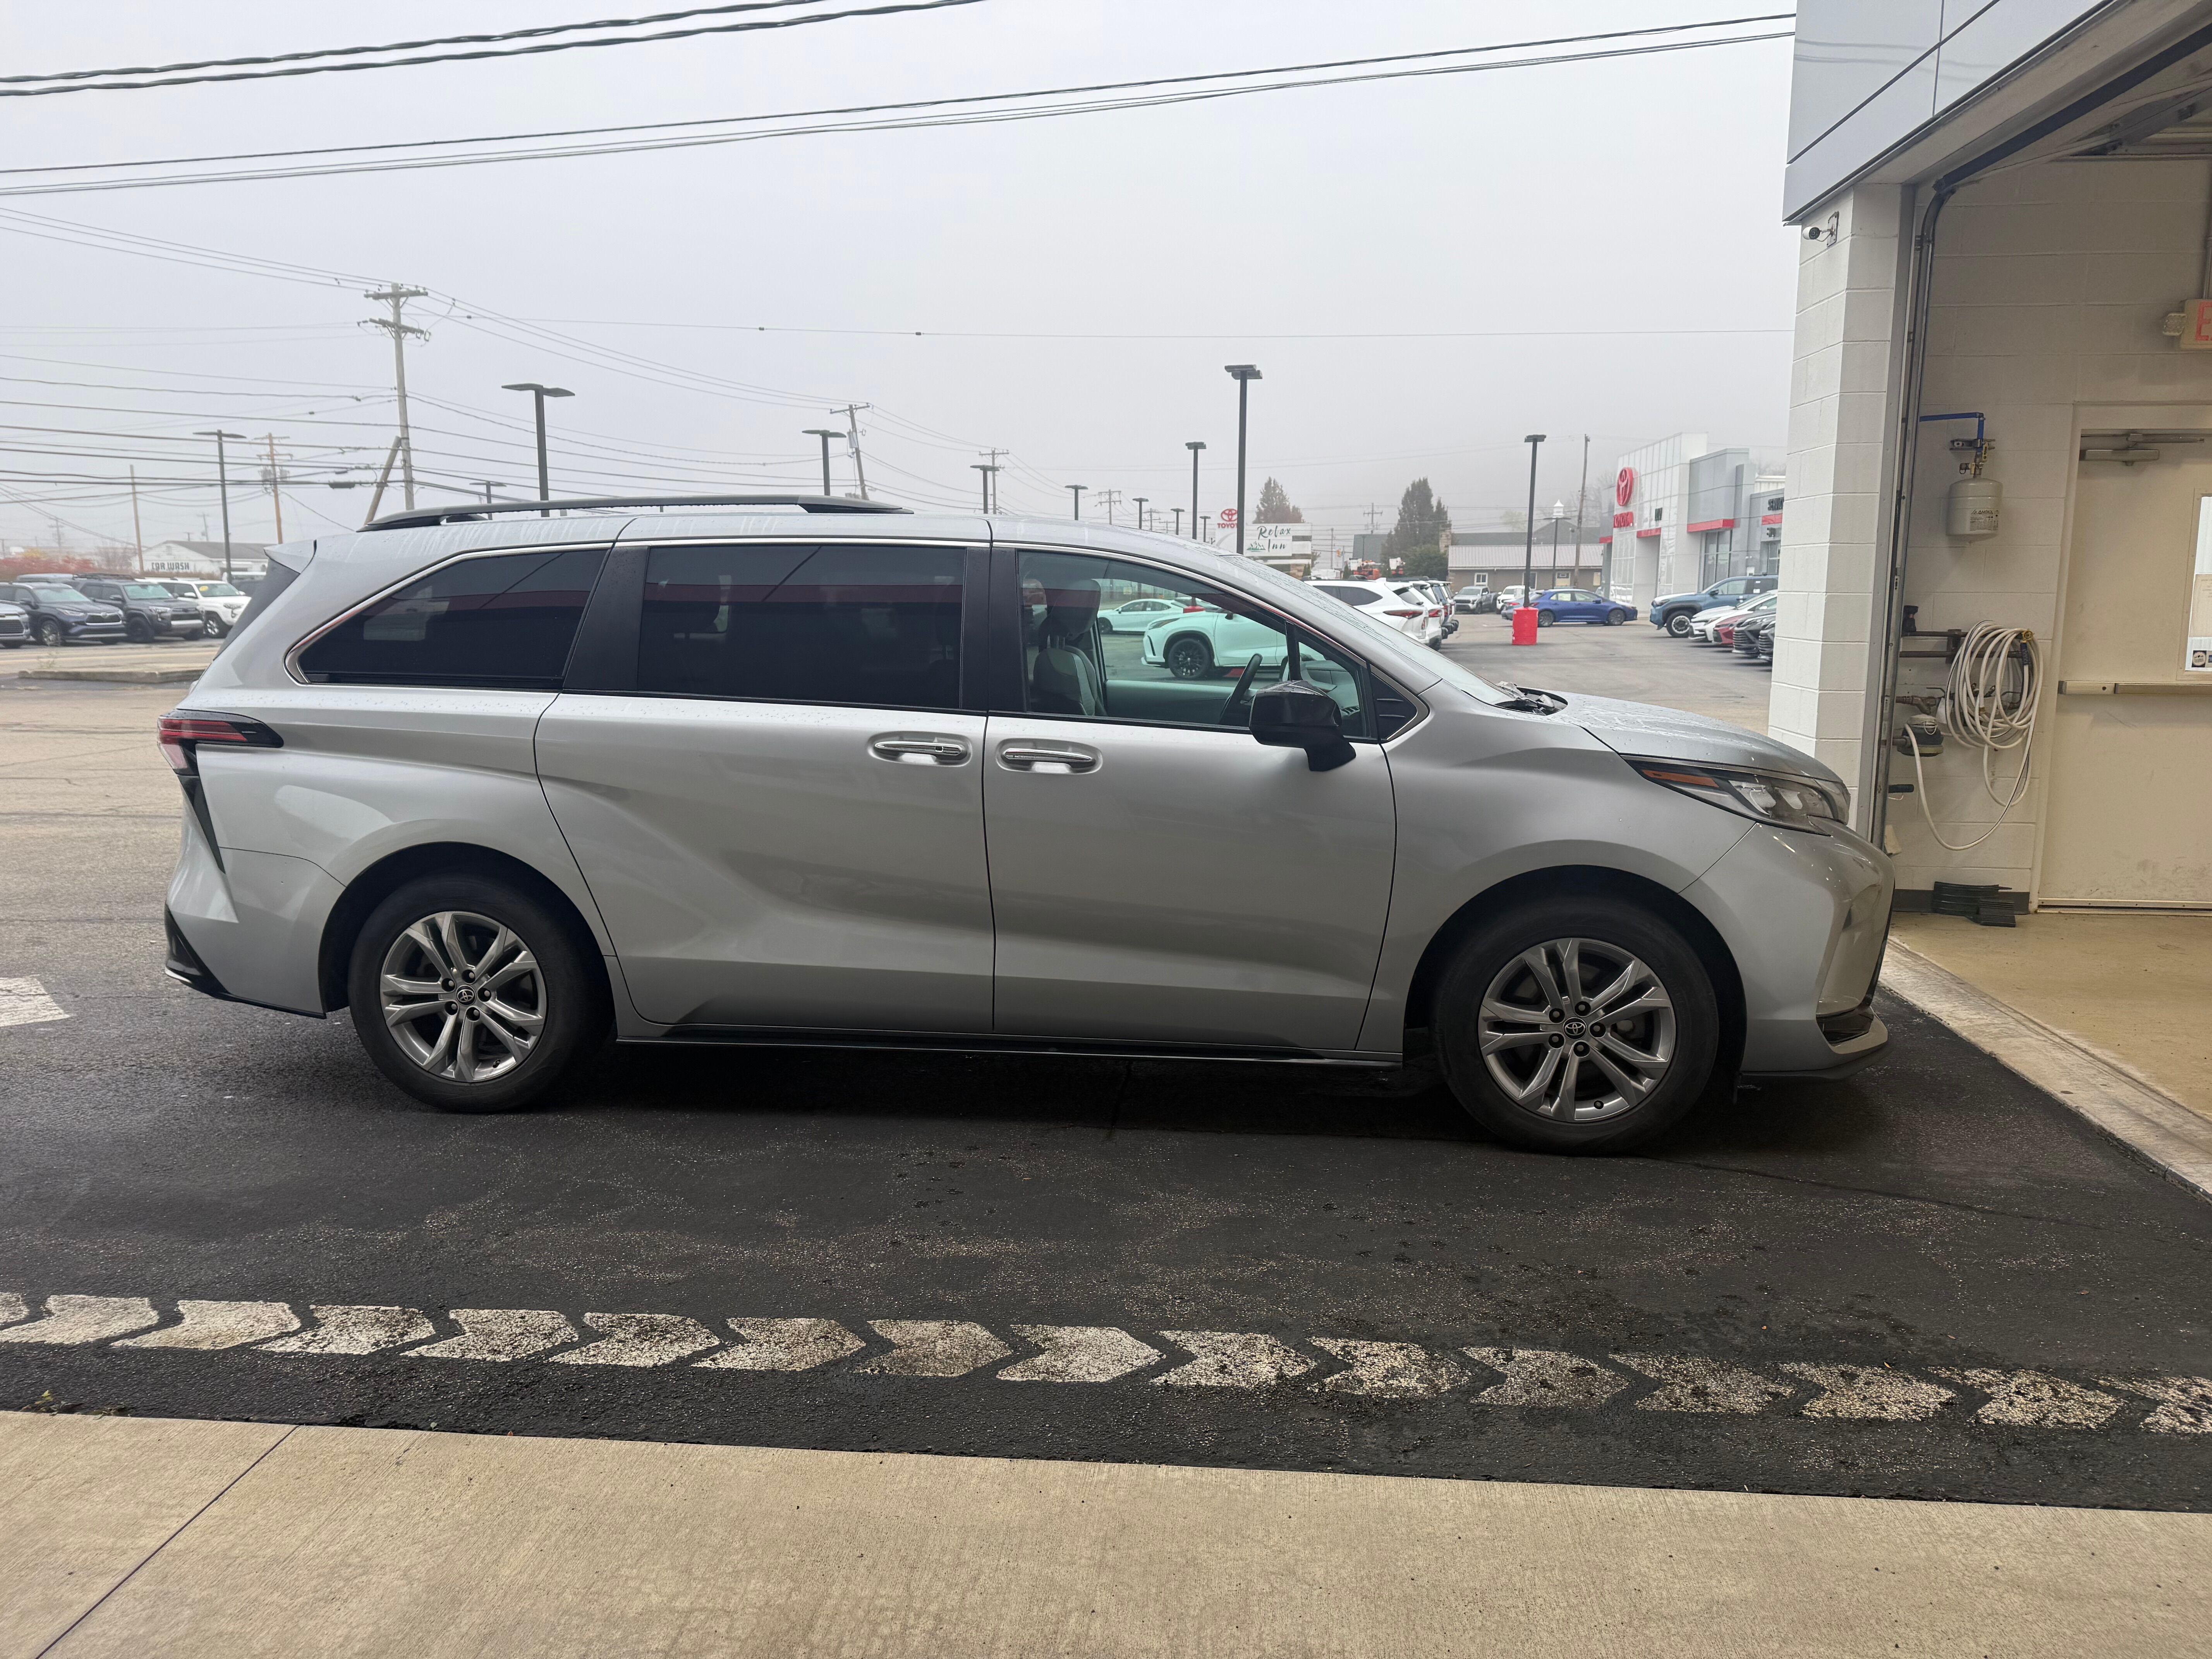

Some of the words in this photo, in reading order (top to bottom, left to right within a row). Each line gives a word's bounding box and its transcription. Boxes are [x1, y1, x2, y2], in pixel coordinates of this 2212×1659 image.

[2195, 302, 2212, 341] E
[1257, 526, 1291, 540] Relax
[1268, 539, 1286, 553] Inn
[151, 562, 165, 570] CAR
[167, 562, 189, 570] WASH
